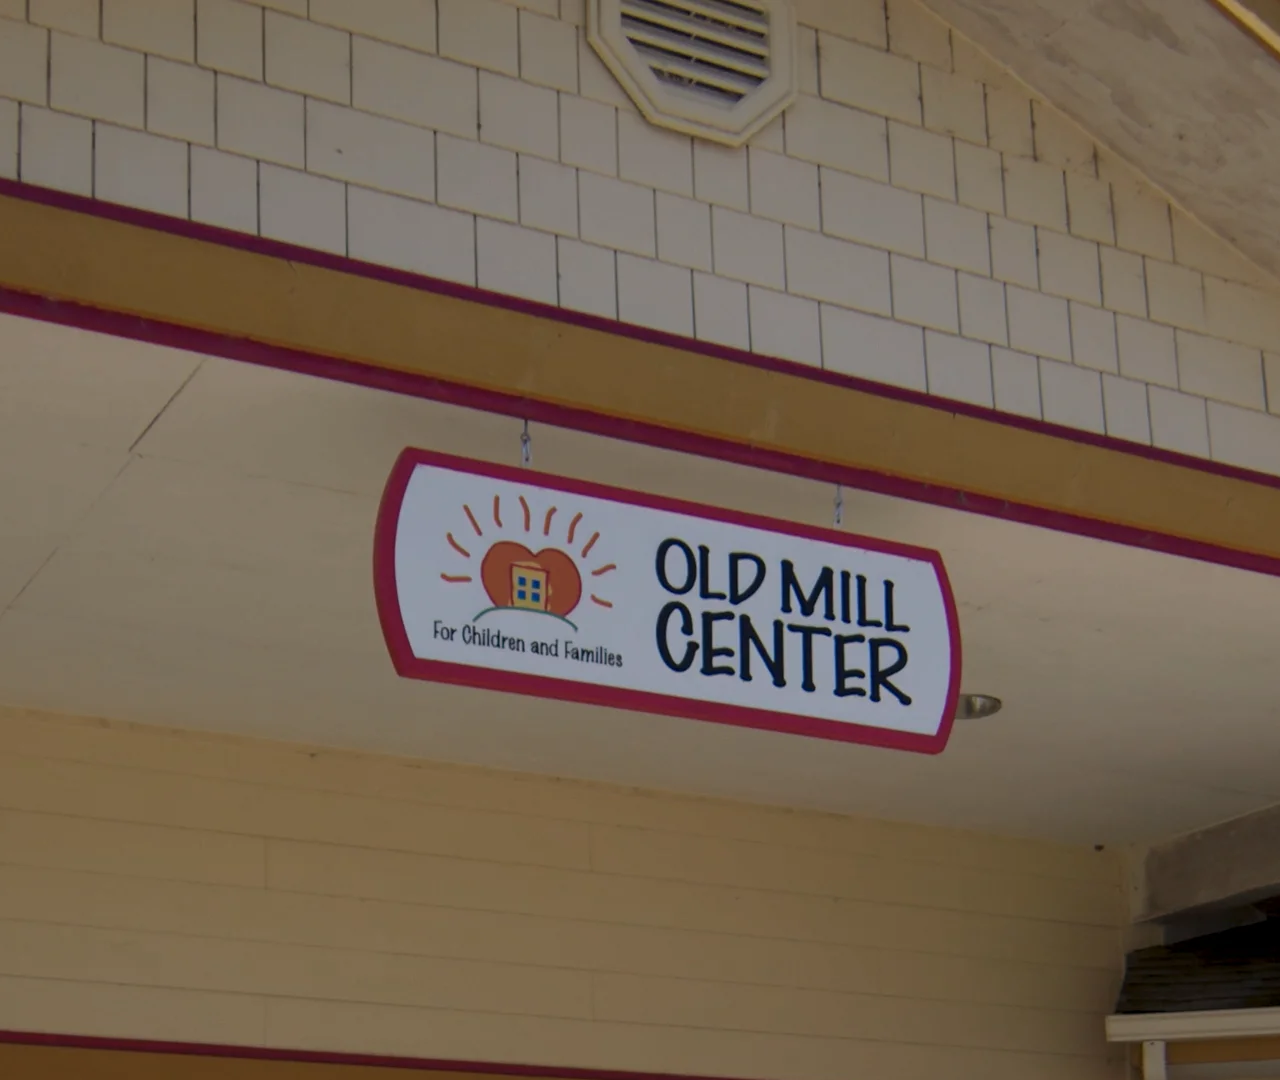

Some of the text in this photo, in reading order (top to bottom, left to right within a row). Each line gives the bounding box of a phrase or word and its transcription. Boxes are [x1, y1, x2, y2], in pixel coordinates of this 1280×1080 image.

[655, 537, 911, 632] OLD MILL
[433, 620, 623, 667] For Children and Families
[655, 600, 912, 706] CENTER
